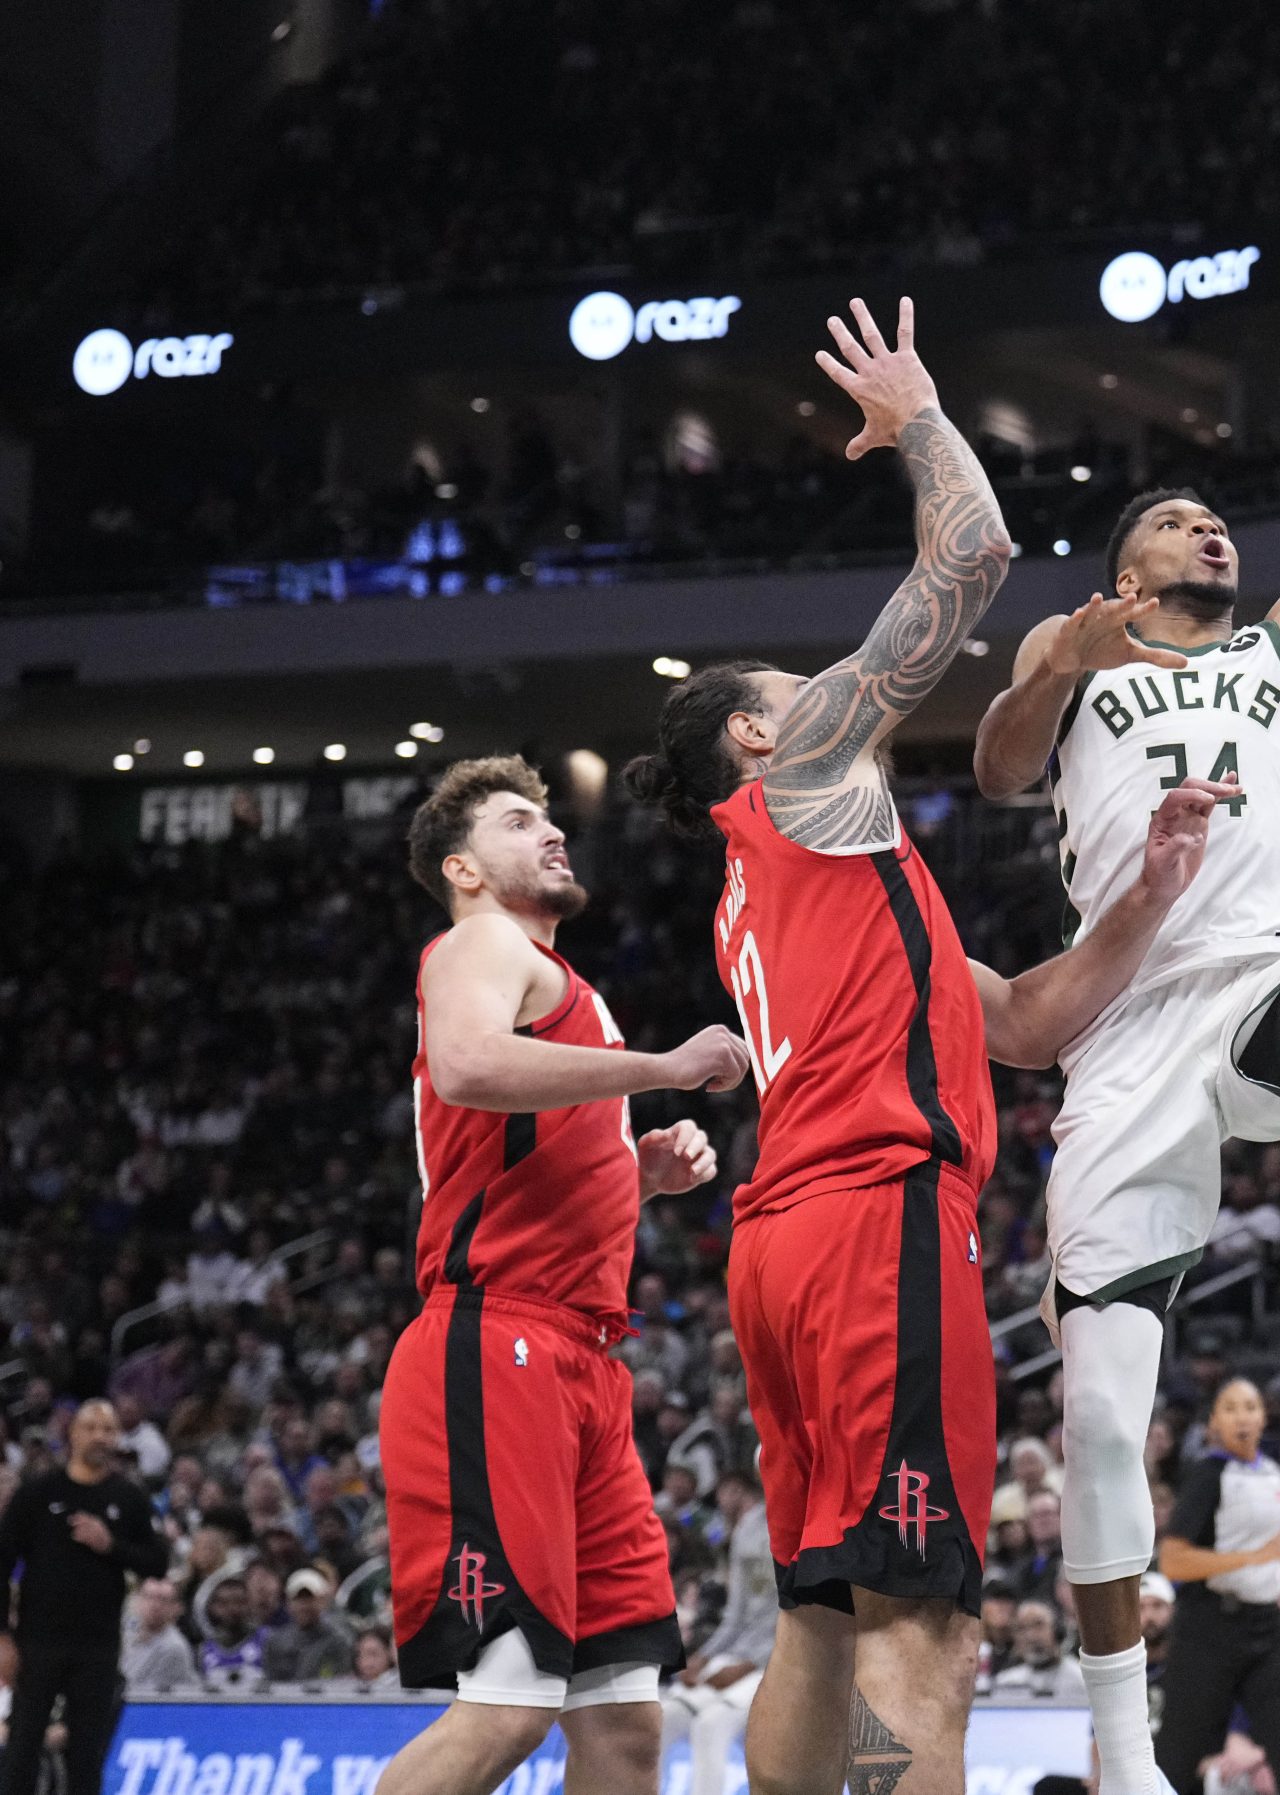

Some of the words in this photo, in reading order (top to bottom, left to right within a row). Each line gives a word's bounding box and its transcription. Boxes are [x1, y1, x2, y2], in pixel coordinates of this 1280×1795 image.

[1167, 245, 1261, 303] razr
[633, 295, 742, 344] razr
[133, 332, 234, 380] razr
